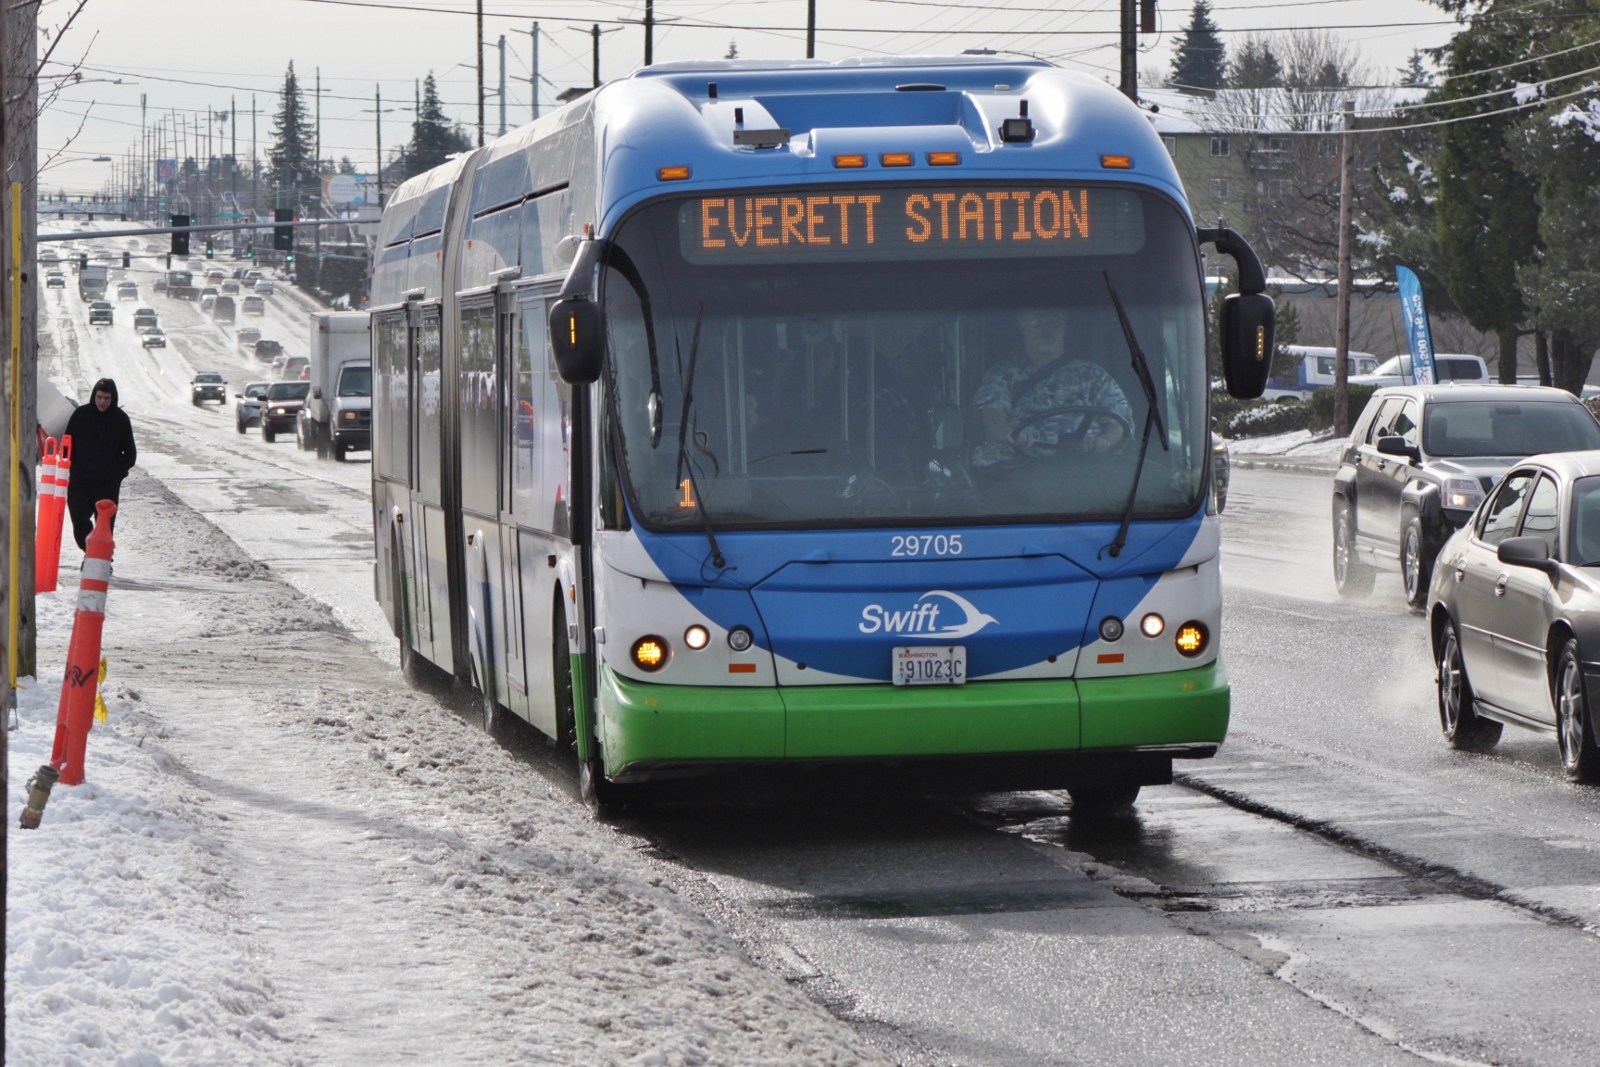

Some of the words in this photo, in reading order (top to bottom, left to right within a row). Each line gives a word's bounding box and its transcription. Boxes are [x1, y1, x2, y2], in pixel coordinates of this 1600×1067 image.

[160, 160, 174, 179] 6
[702, 195, 881, 248] EVERETT
[905, 189, 1089, 243] STATION
[679, 478, 695, 507] 1
[891, 534, 963, 557] 29705
[859, 603, 940, 634] Swift
[906, 659, 962, 678] 91023C
